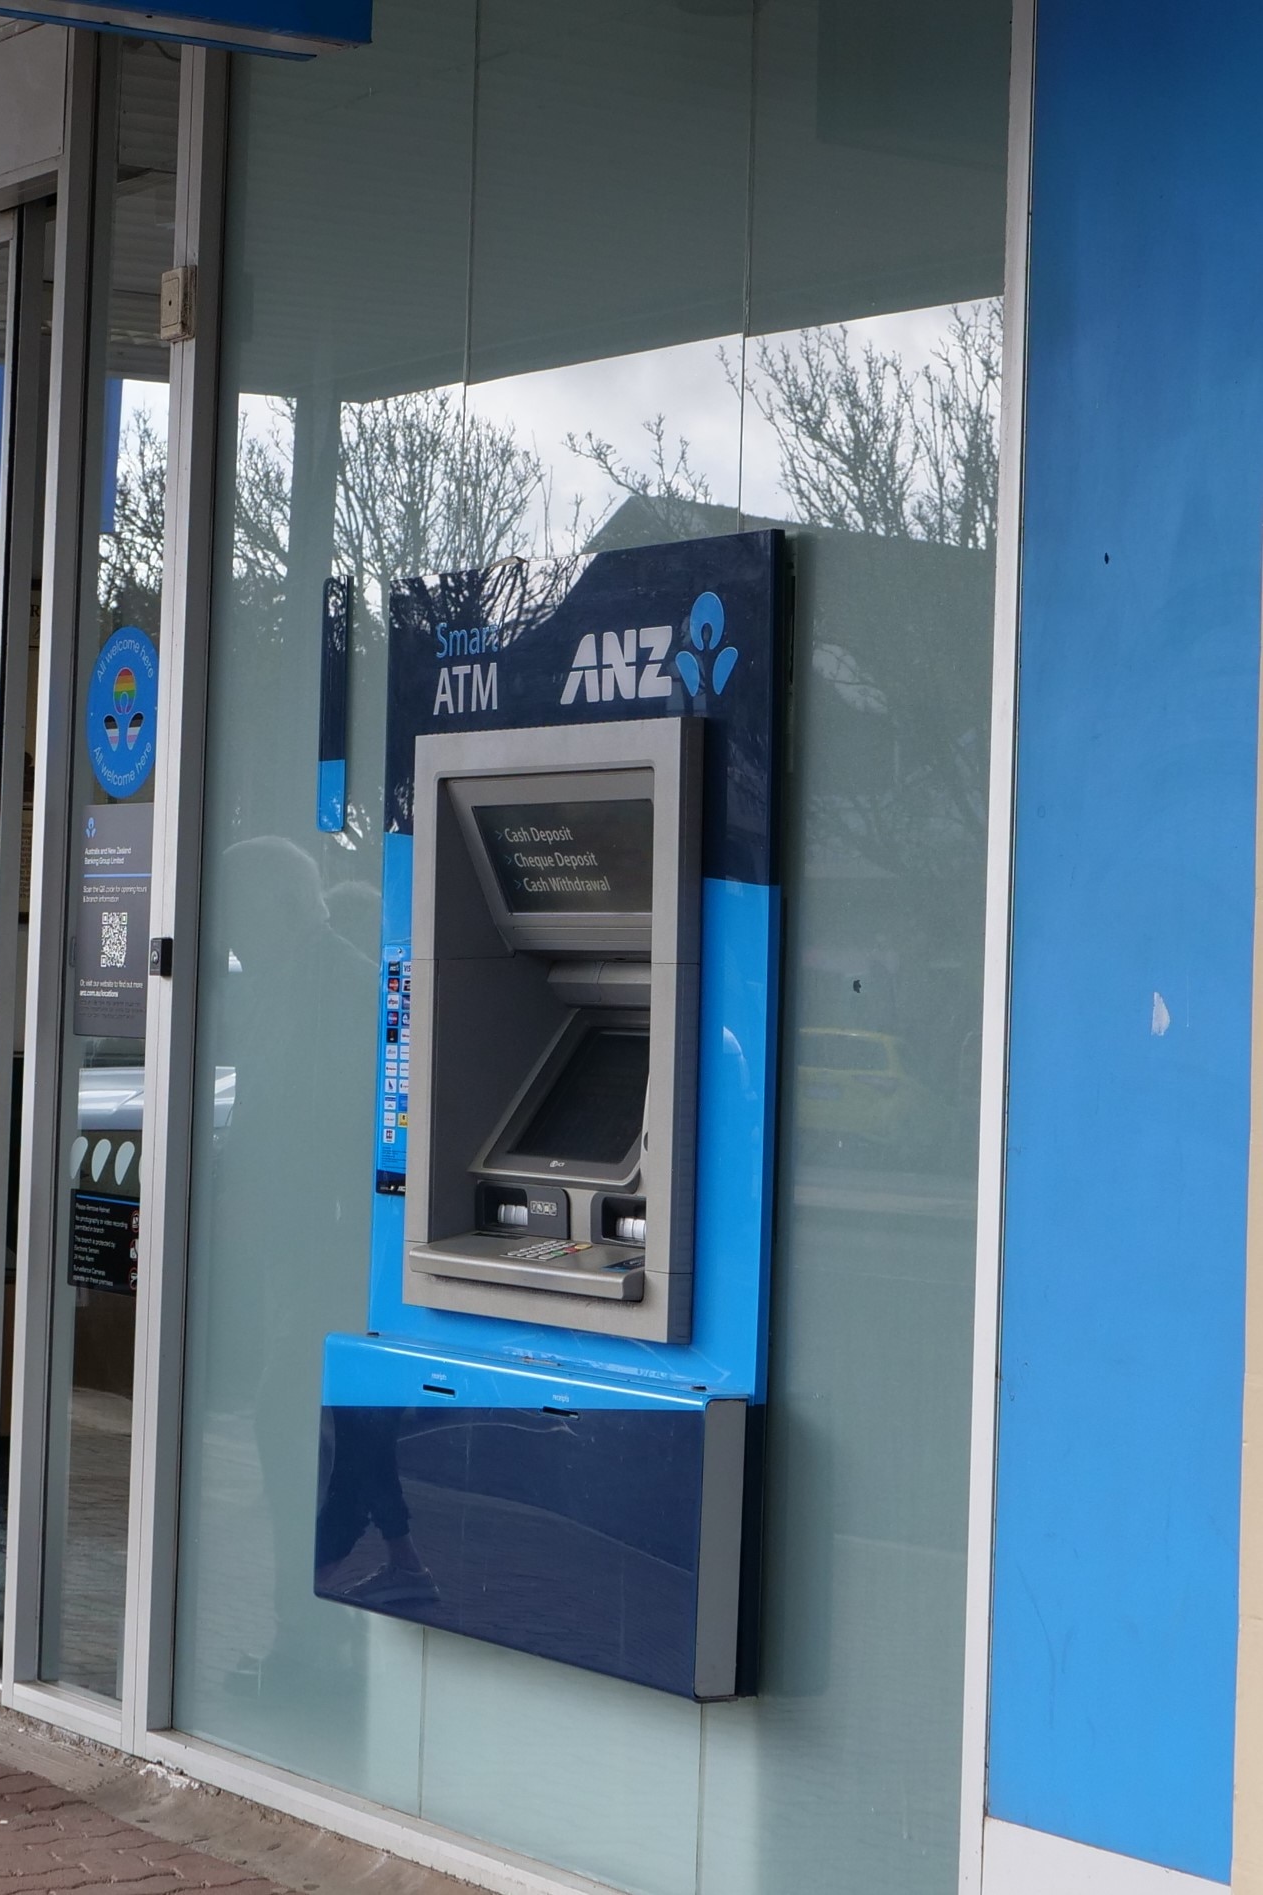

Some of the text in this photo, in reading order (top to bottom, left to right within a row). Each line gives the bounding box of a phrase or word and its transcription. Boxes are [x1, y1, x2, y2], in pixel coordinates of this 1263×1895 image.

[436, 621, 499, 659] Smart
[97, 639, 153, 683] All welcome here
[560, 625, 673, 705] ANZ
[433, 662, 499, 716] ATM
[93, 742, 152, 786] All welcome here
[504, 826, 573, 845] Cash Deposit
[514, 852, 598, 870] Cheque Deposit
[523, 876, 611, 892] Cash Withdrawal
